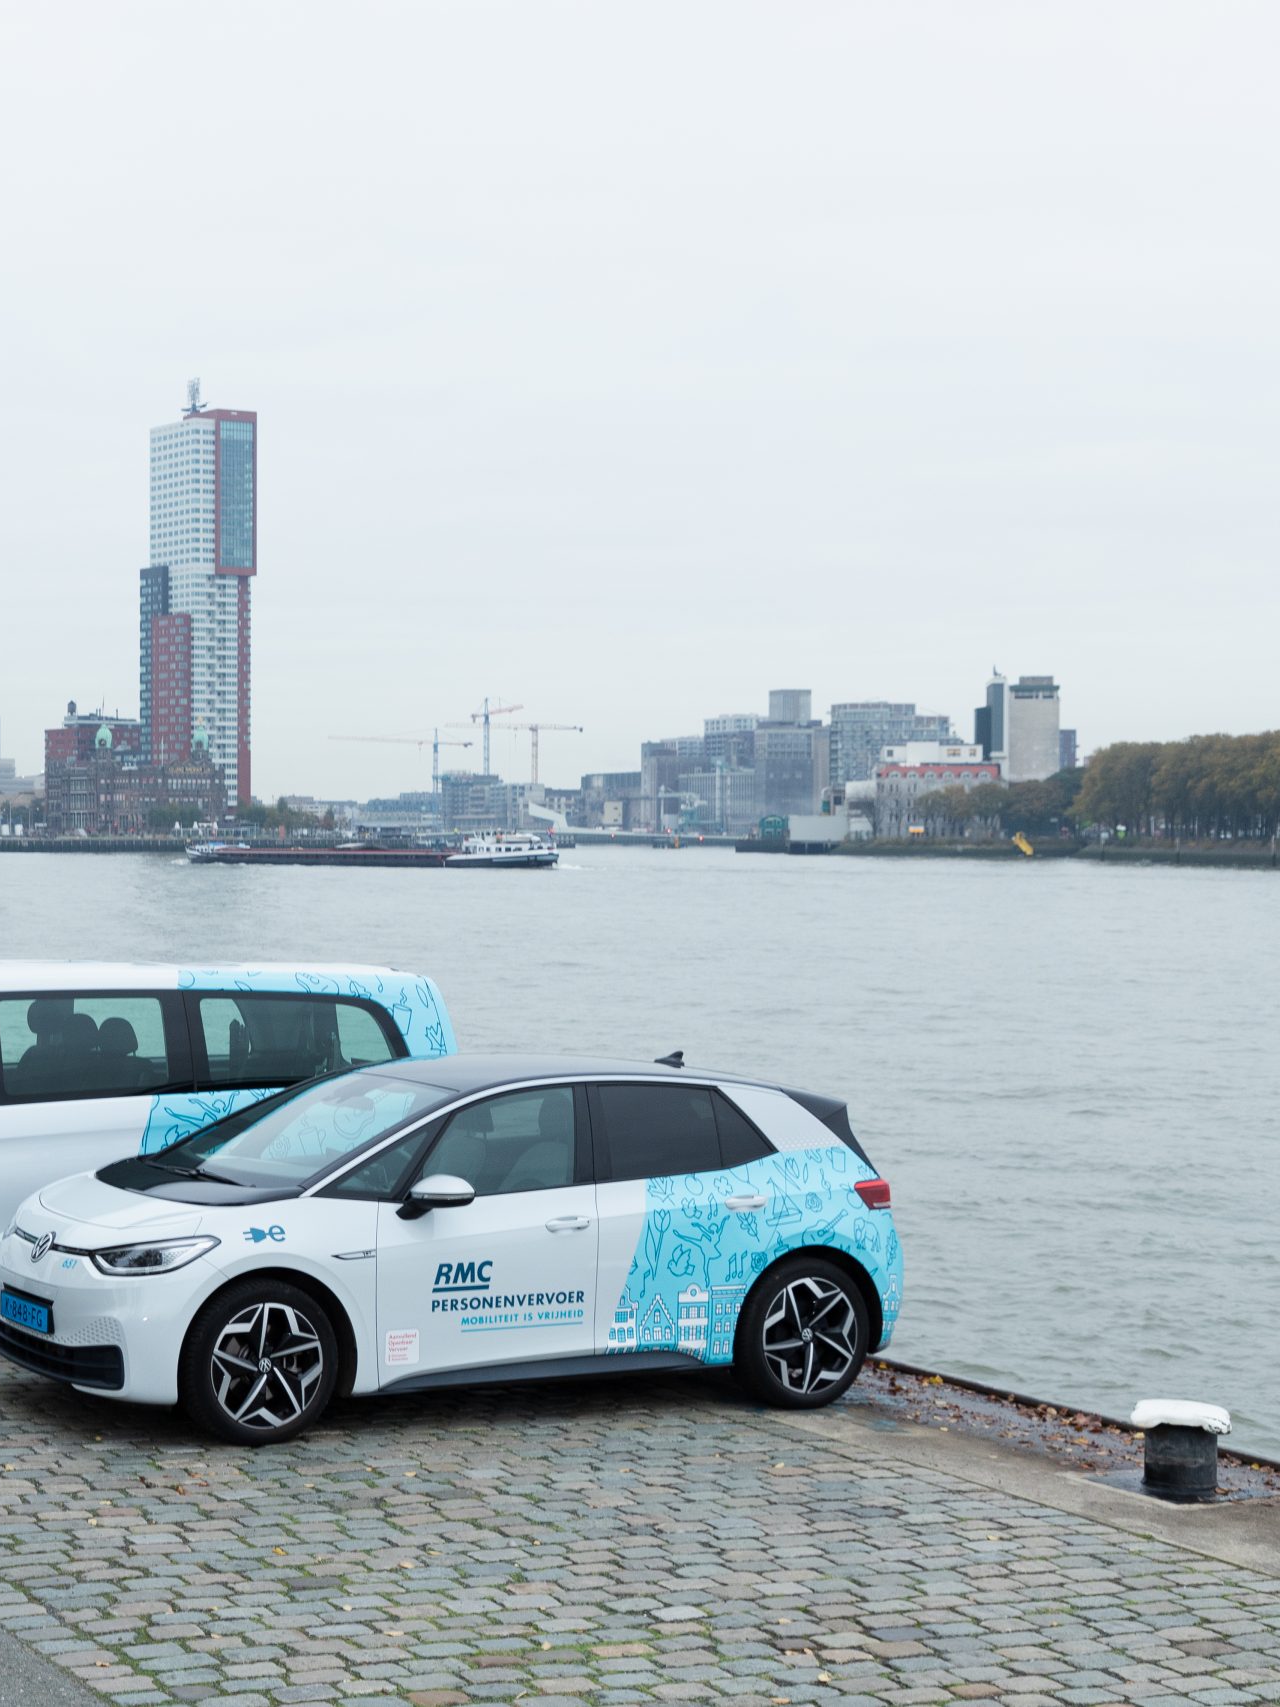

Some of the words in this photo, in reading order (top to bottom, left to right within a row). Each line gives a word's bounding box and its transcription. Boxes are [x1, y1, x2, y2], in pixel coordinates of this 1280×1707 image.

[434, 1260, 493, 1285] RMC
[431, 1290, 585, 1313] PERSONENVERVOER
[461, 1313, 519, 1326] MOBILITEIT
[523, 1312, 533, 1321] IS
[538, 1309, 584, 1320] VRIJHEID
